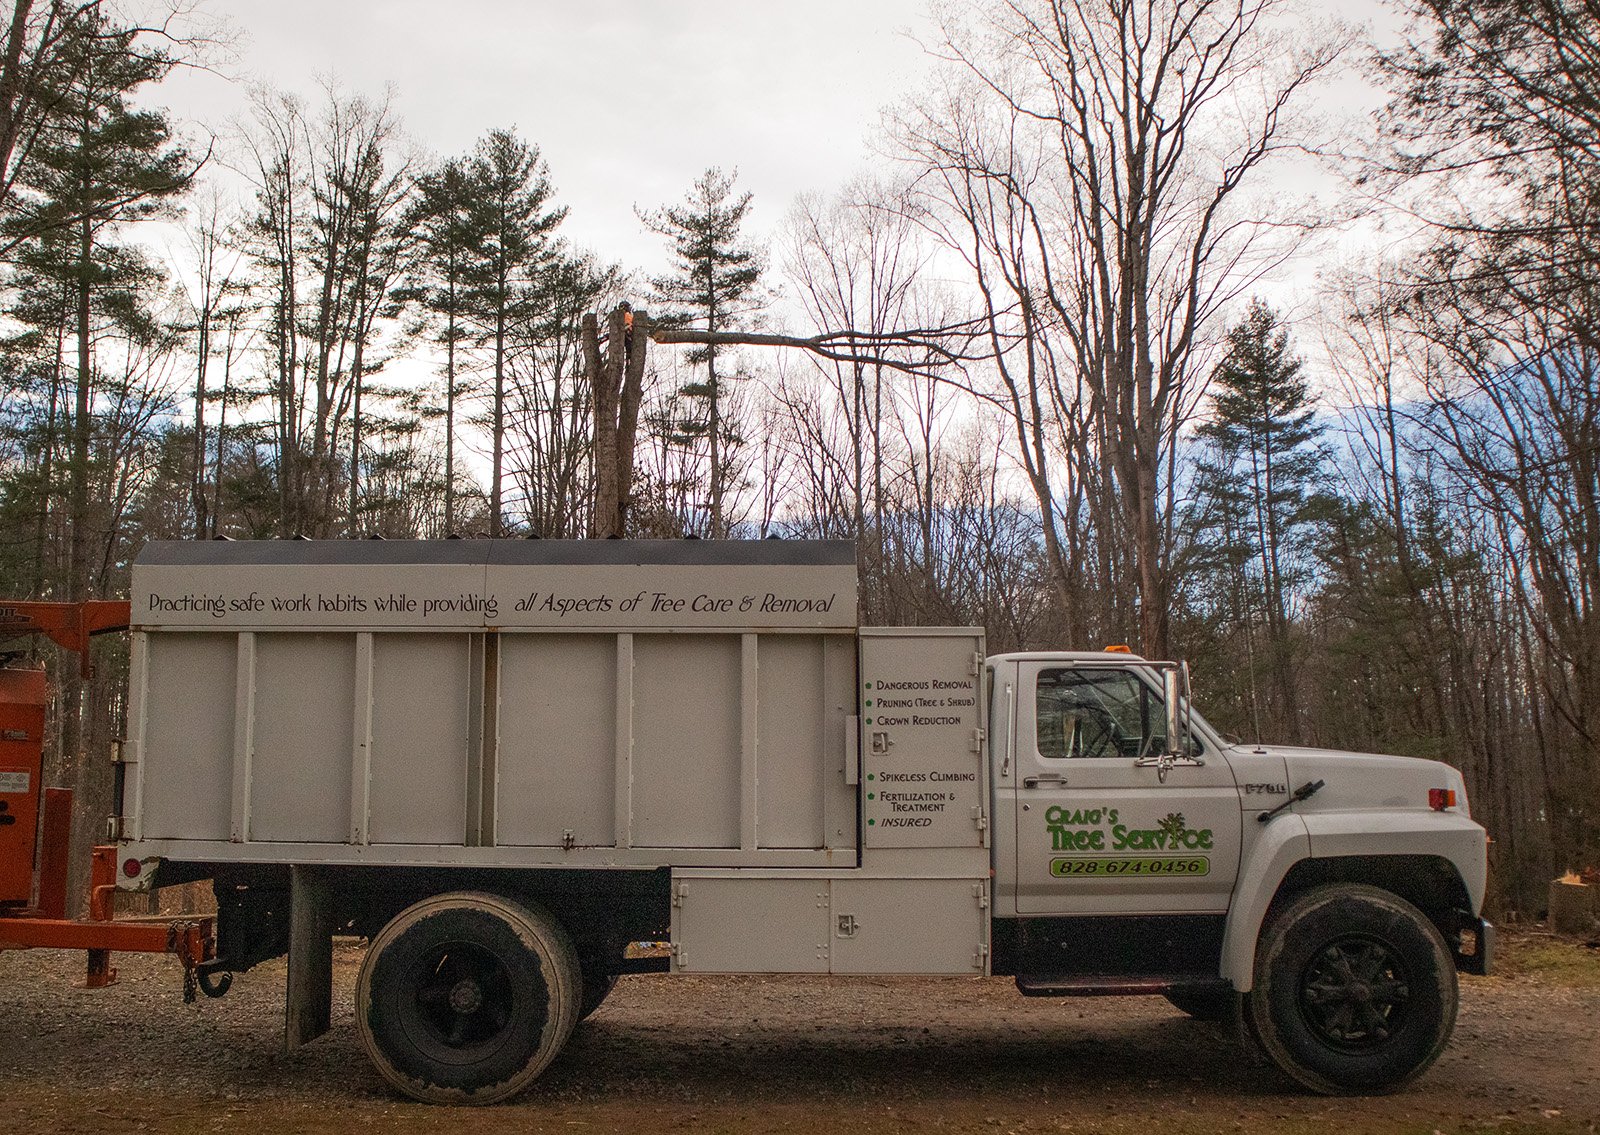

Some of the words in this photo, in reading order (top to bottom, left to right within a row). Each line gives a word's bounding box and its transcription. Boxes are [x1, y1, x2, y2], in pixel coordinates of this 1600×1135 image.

[148, 593, 227, 619] Practicing
[228, 591, 266, 612] safe
[270, 593, 312, 612] work
[317, 593, 368, 613] habits
[373, 593, 418, 613] while
[423, 593, 499, 619] providing
[513, 592, 539, 612] all
[538, 592, 614, 618] Aspects
[618, 590, 648, 613] of
[650, 592, 686, 613] Tree
[690, 593, 734, 613] Care
[738, 595, 756, 613] &
[759, 592, 836, 613] Removal
[876, 679, 930, 691] DANGEROUS
[932, 679, 973, 690] REMOVAL
[876, 697, 913, 708] PRUNING
[939, 699, 945, 707] &
[876, 715, 910, 726] CROWN
[912, 715, 961, 726] REDUCTION
[879, 771, 927, 783] SPIKELESS
[929, 771, 976, 782] CLIMBING
[880, 792, 946, 801] FERTILIZATION
[948, 792, 956, 802] &
[891, 802, 945, 812] TREATMENT
[1045, 806, 1119, 825] CRAIG'S
[880, 817, 933, 828] INSURED
[1047, 825, 1105, 850] TREE
[1060, 861, 1200, 874] 828-674-0456
